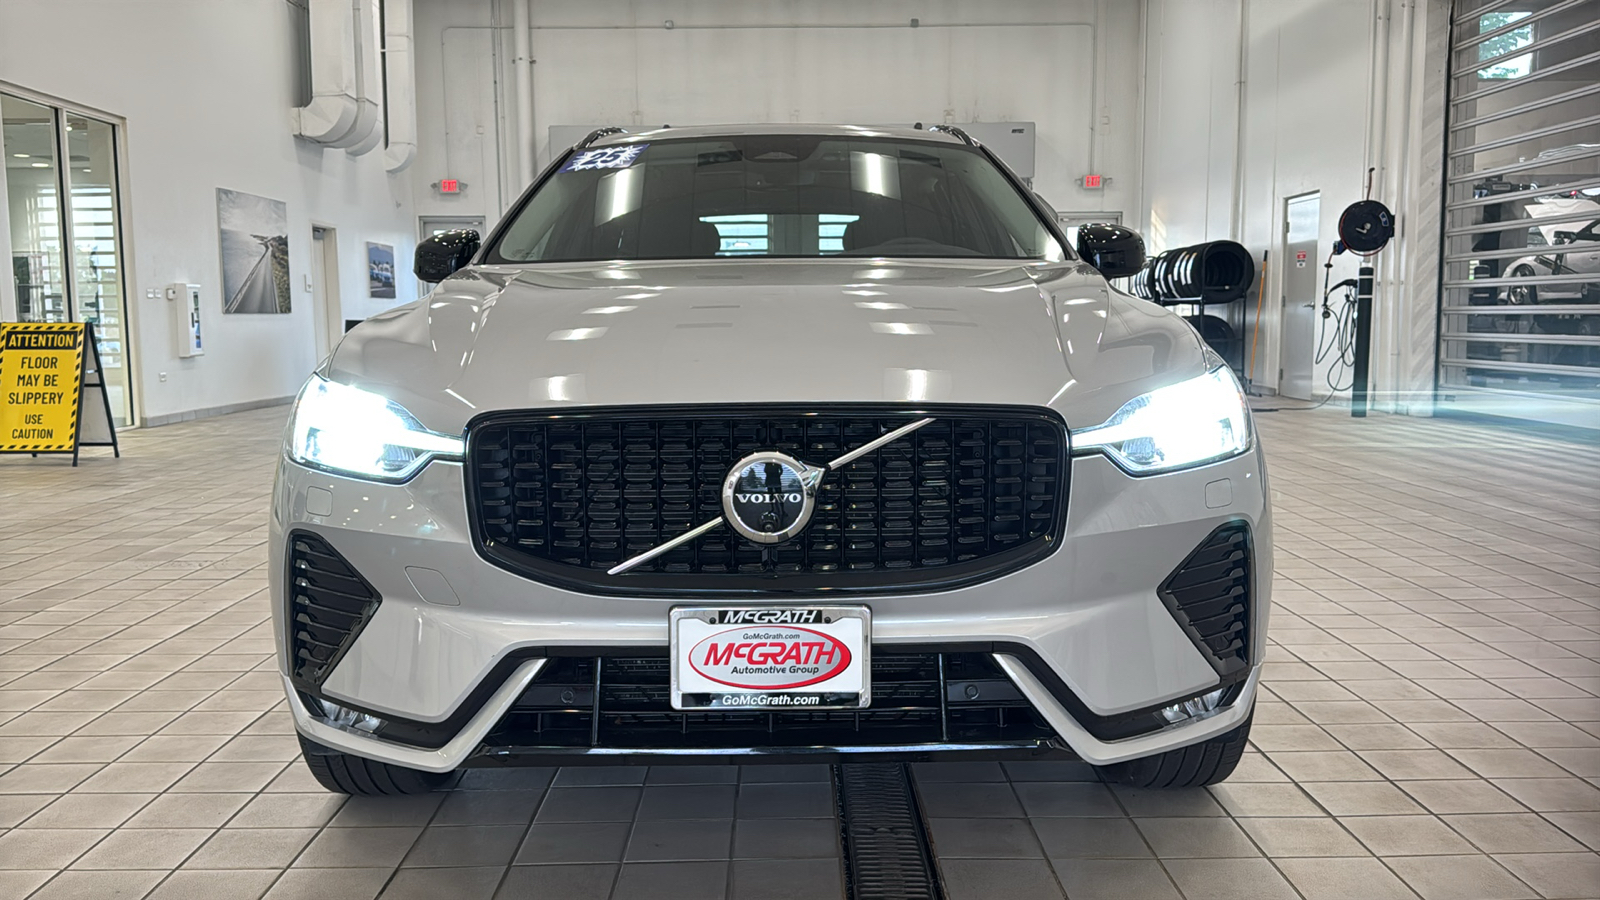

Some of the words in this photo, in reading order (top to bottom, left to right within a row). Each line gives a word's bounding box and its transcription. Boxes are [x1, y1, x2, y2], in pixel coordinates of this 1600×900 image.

[580, 150, 626, 165] 25
[1086, 175, 1100, 187] EXIT
[8, 334, 74, 348] ATTENTION
[20, 356, 59, 369] FLOOR
[16, 374, 41, 387] MAY
[43, 374, 59, 387] BE
[8, 392, 64, 405] SLIPPERY
[24, 414, 43, 425] USE
[11, 428, 54, 439] CAUTION
[735, 493, 802, 503] VOLVO
[742, 632, 801, 641] GoMcGrath.com
[731, 665, 787, 675] Automotive
[788, 665, 820, 676] Group
[722, 695, 820, 705] GoMcGrath.com
